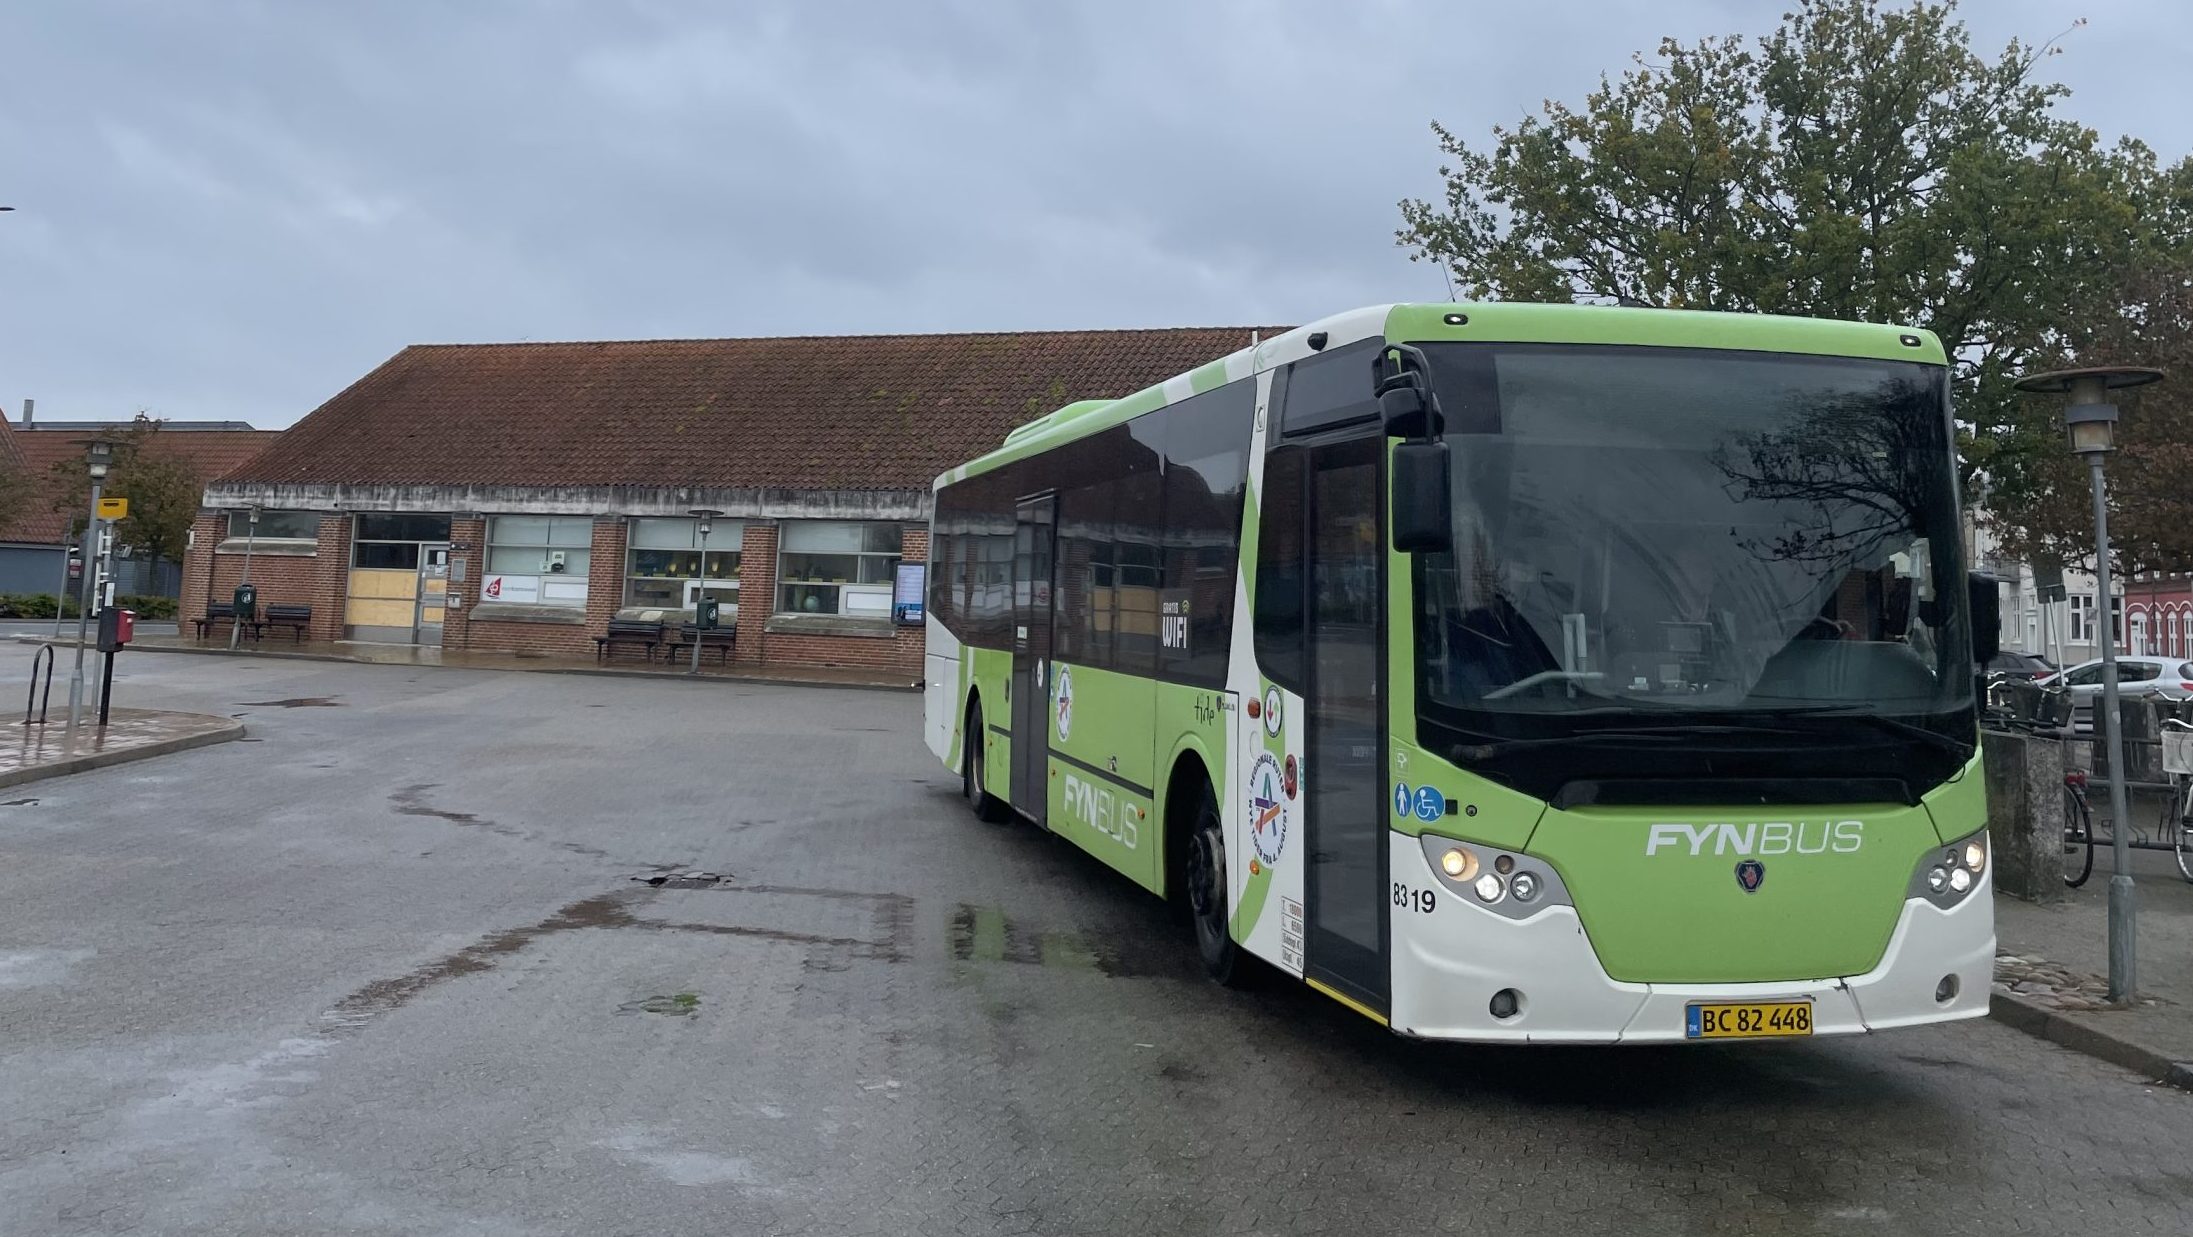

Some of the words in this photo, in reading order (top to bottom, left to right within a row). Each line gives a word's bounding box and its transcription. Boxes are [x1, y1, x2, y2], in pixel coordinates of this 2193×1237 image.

[1162, 616, 1188, 649] WIFI
[1064, 774, 1138, 850] FYNBUS
[1645, 820, 1864, 856] FYNBUS
[1393, 882, 1436, 914] 8319
[1702, 1009, 1732, 1033] BC
[1737, 1008, 1763, 1032] 82
[1769, 1007, 1809, 1031] 448
